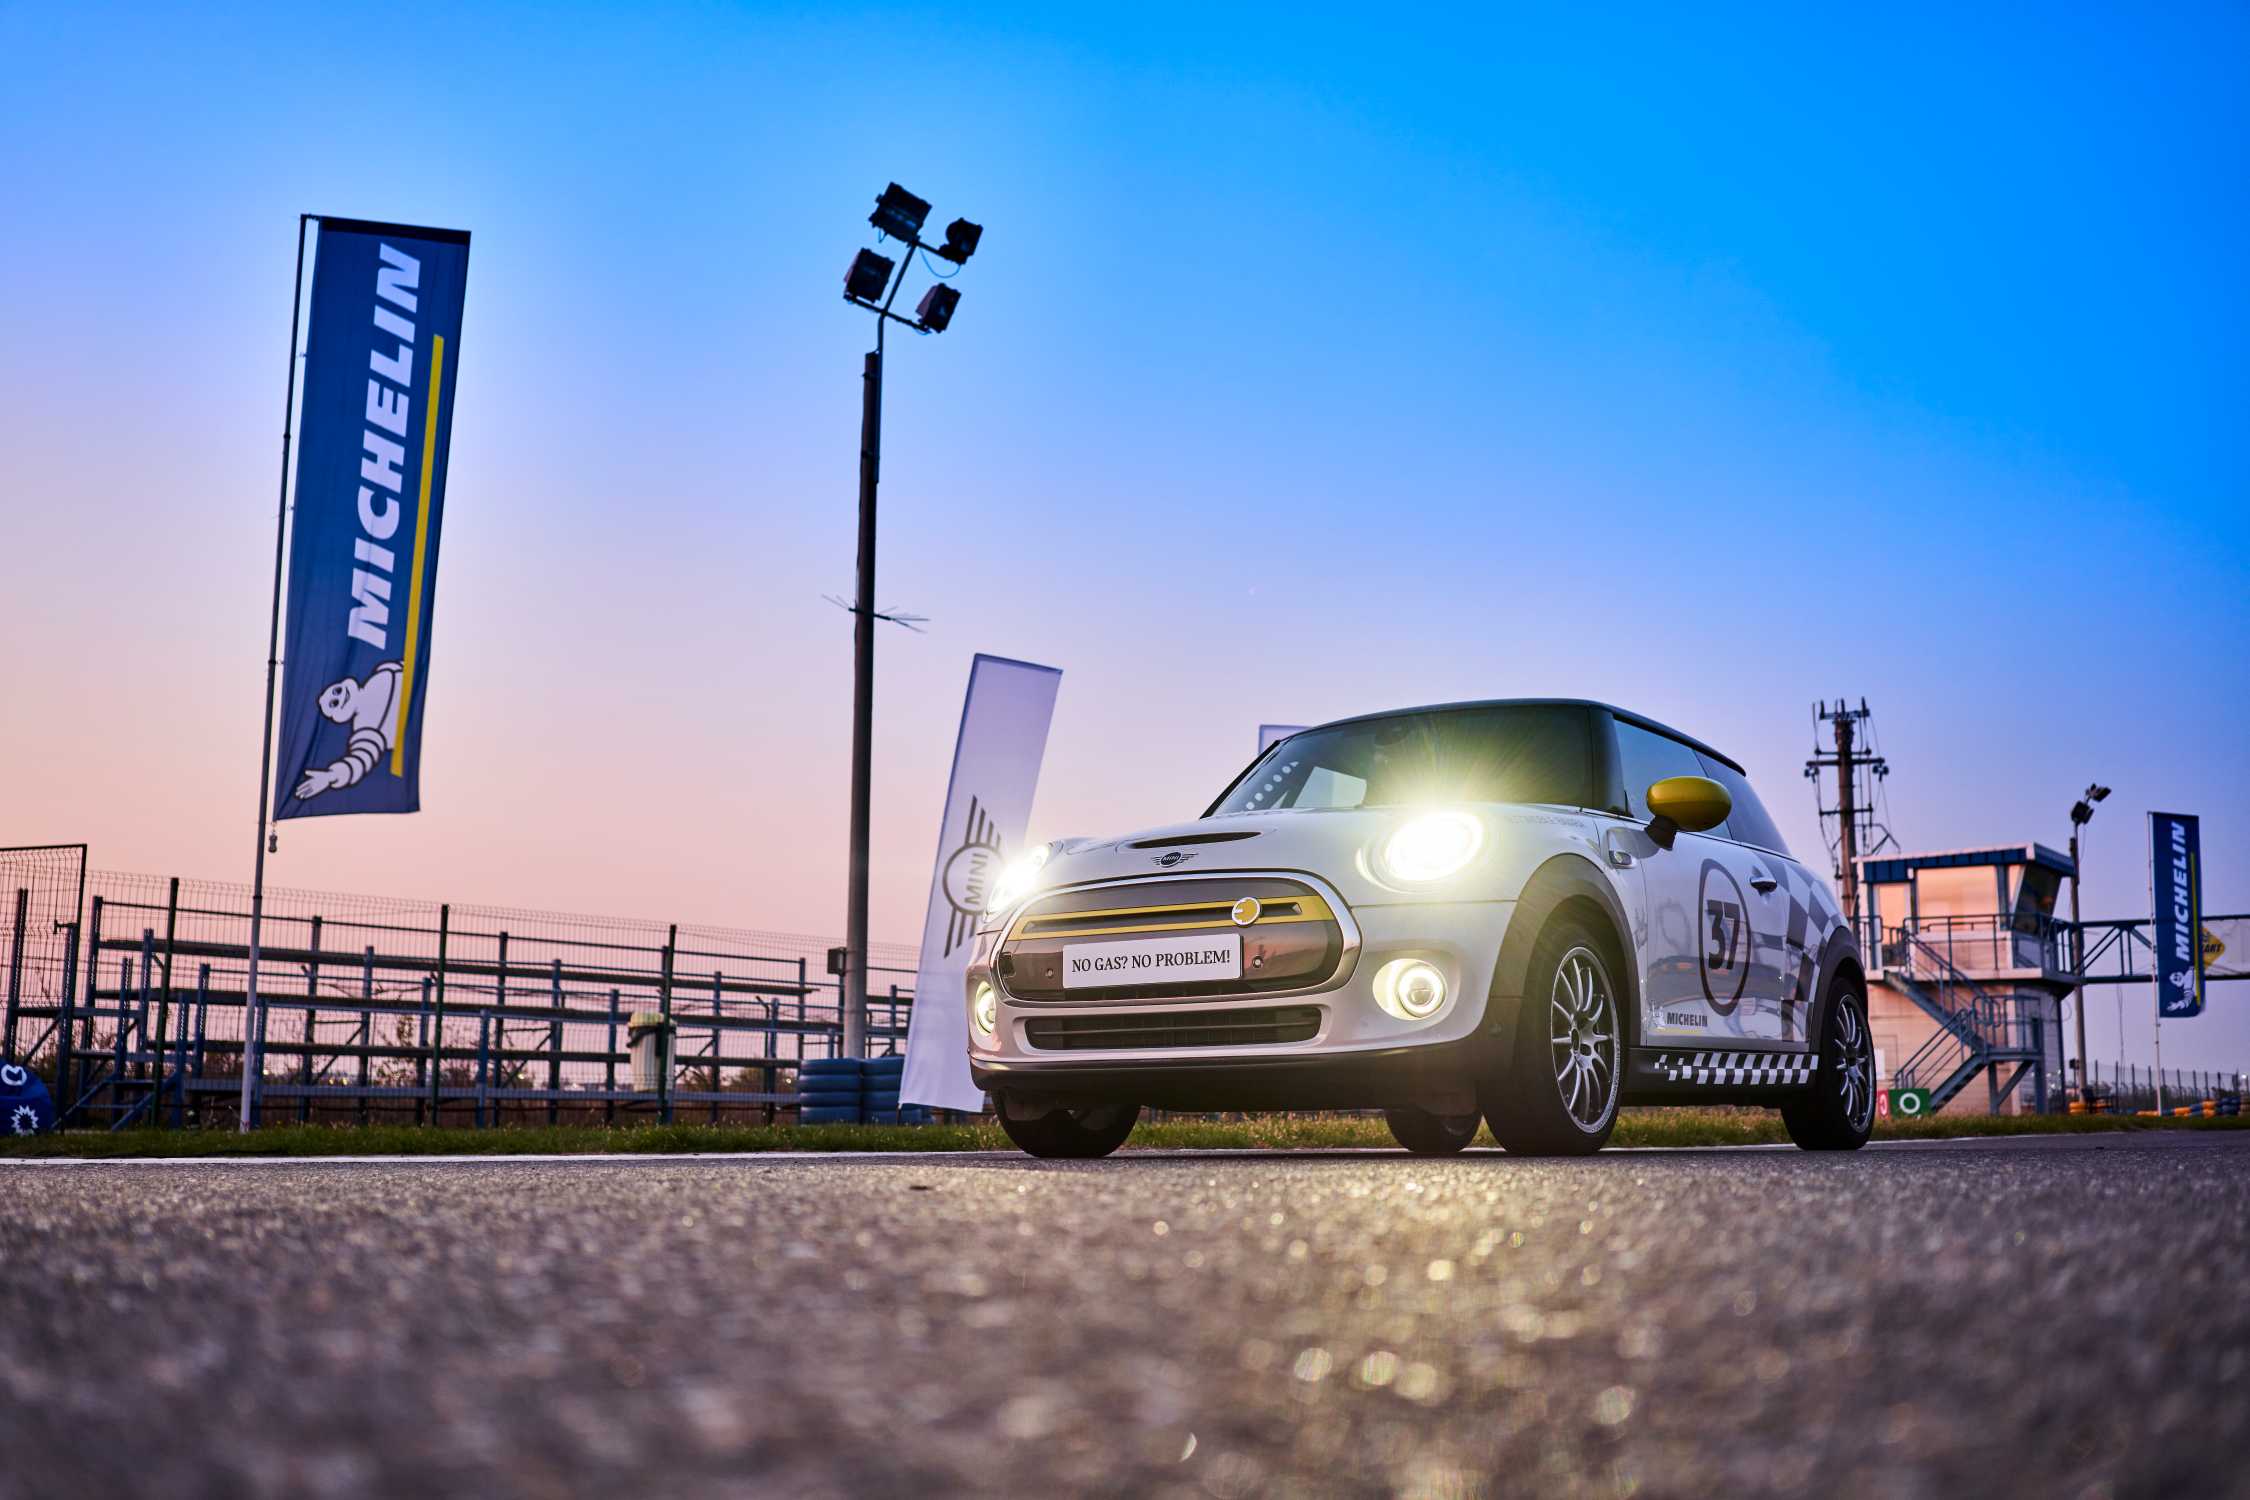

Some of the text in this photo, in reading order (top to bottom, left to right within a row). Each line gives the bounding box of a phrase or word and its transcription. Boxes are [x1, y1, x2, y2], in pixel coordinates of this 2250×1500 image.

[347, 242, 421, 650] MICHELIN
[964, 852, 988, 905] MINI
[2171, 821, 2190, 961] MICHELIN
[1072, 949, 1231, 973] NO GAS? NO PROBLEM!
[1706, 899, 1740, 970] 37
[1667, 1012, 1708, 1027] MICHELIN
